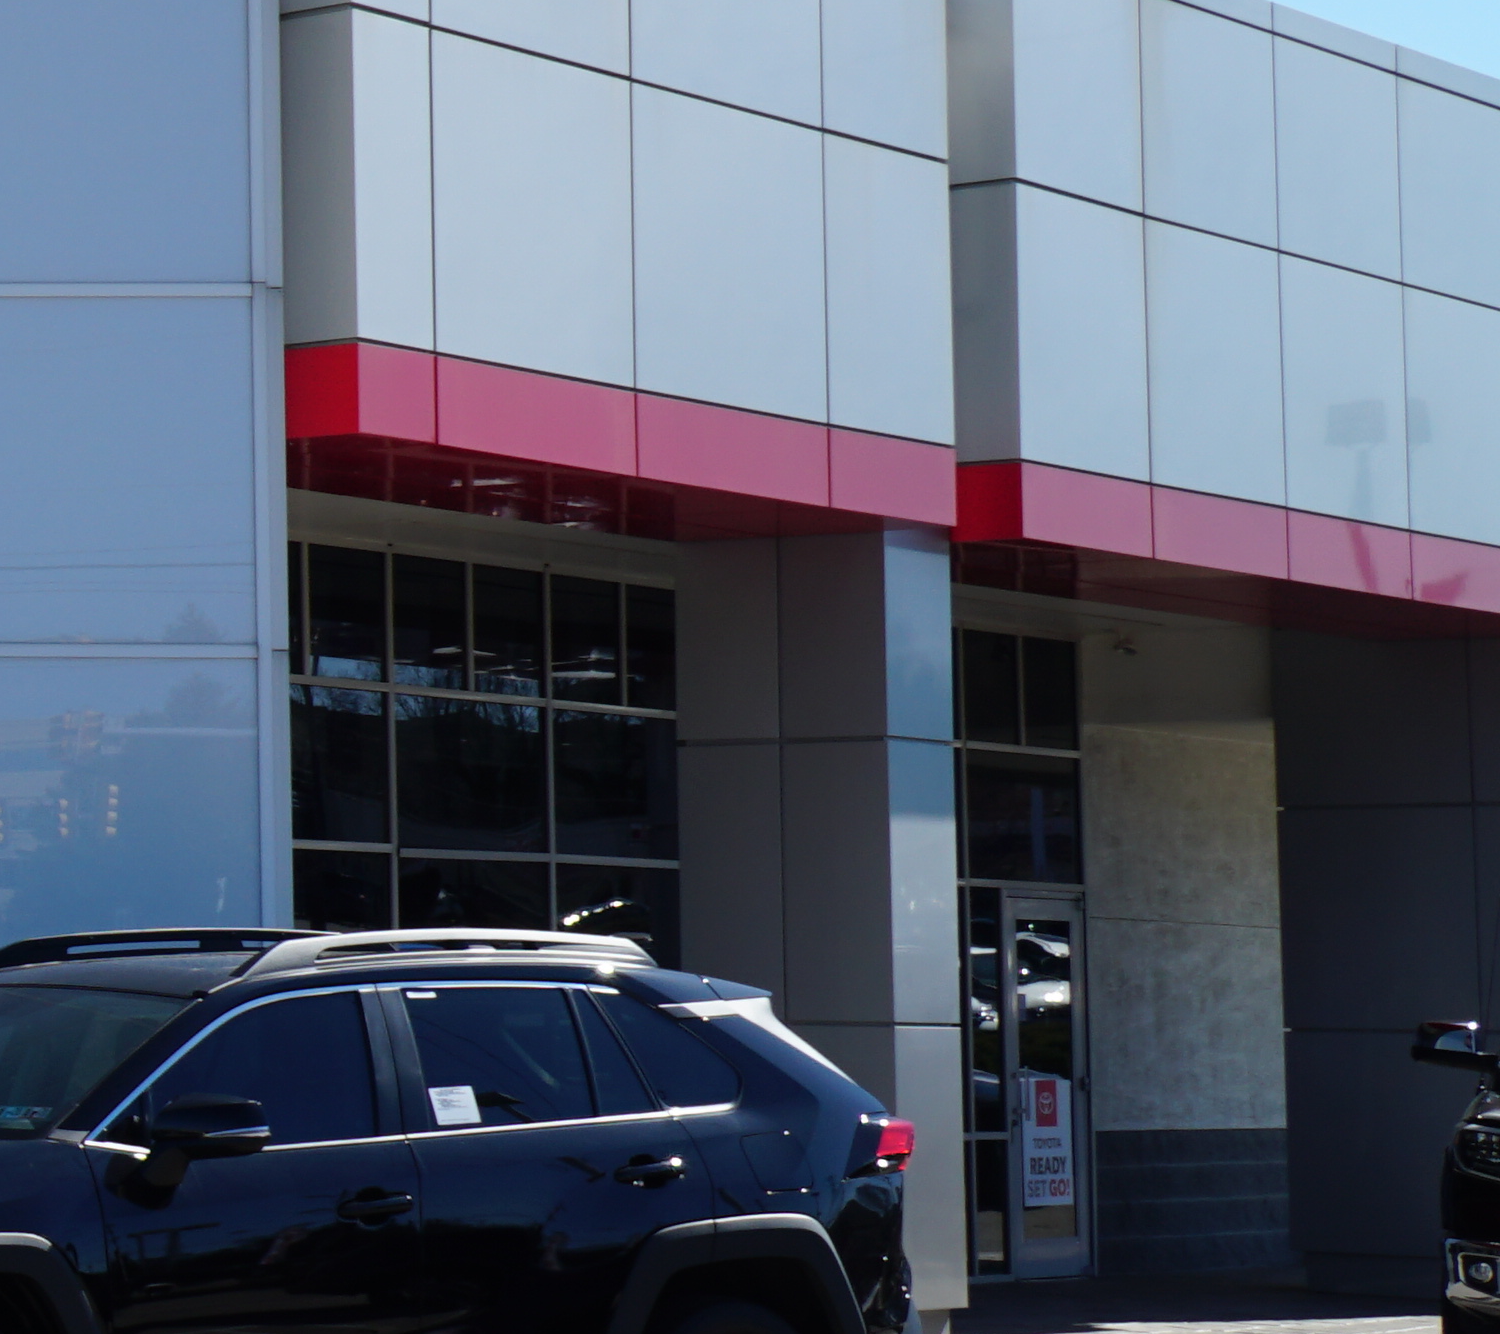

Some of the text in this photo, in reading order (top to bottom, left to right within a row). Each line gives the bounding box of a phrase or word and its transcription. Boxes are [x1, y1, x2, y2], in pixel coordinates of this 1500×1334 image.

[1032, 1137, 1062, 1149] TOYOTA
[1030, 1156, 1067, 1174] READY
[1027, 1178, 1070, 1197] SET GO!
